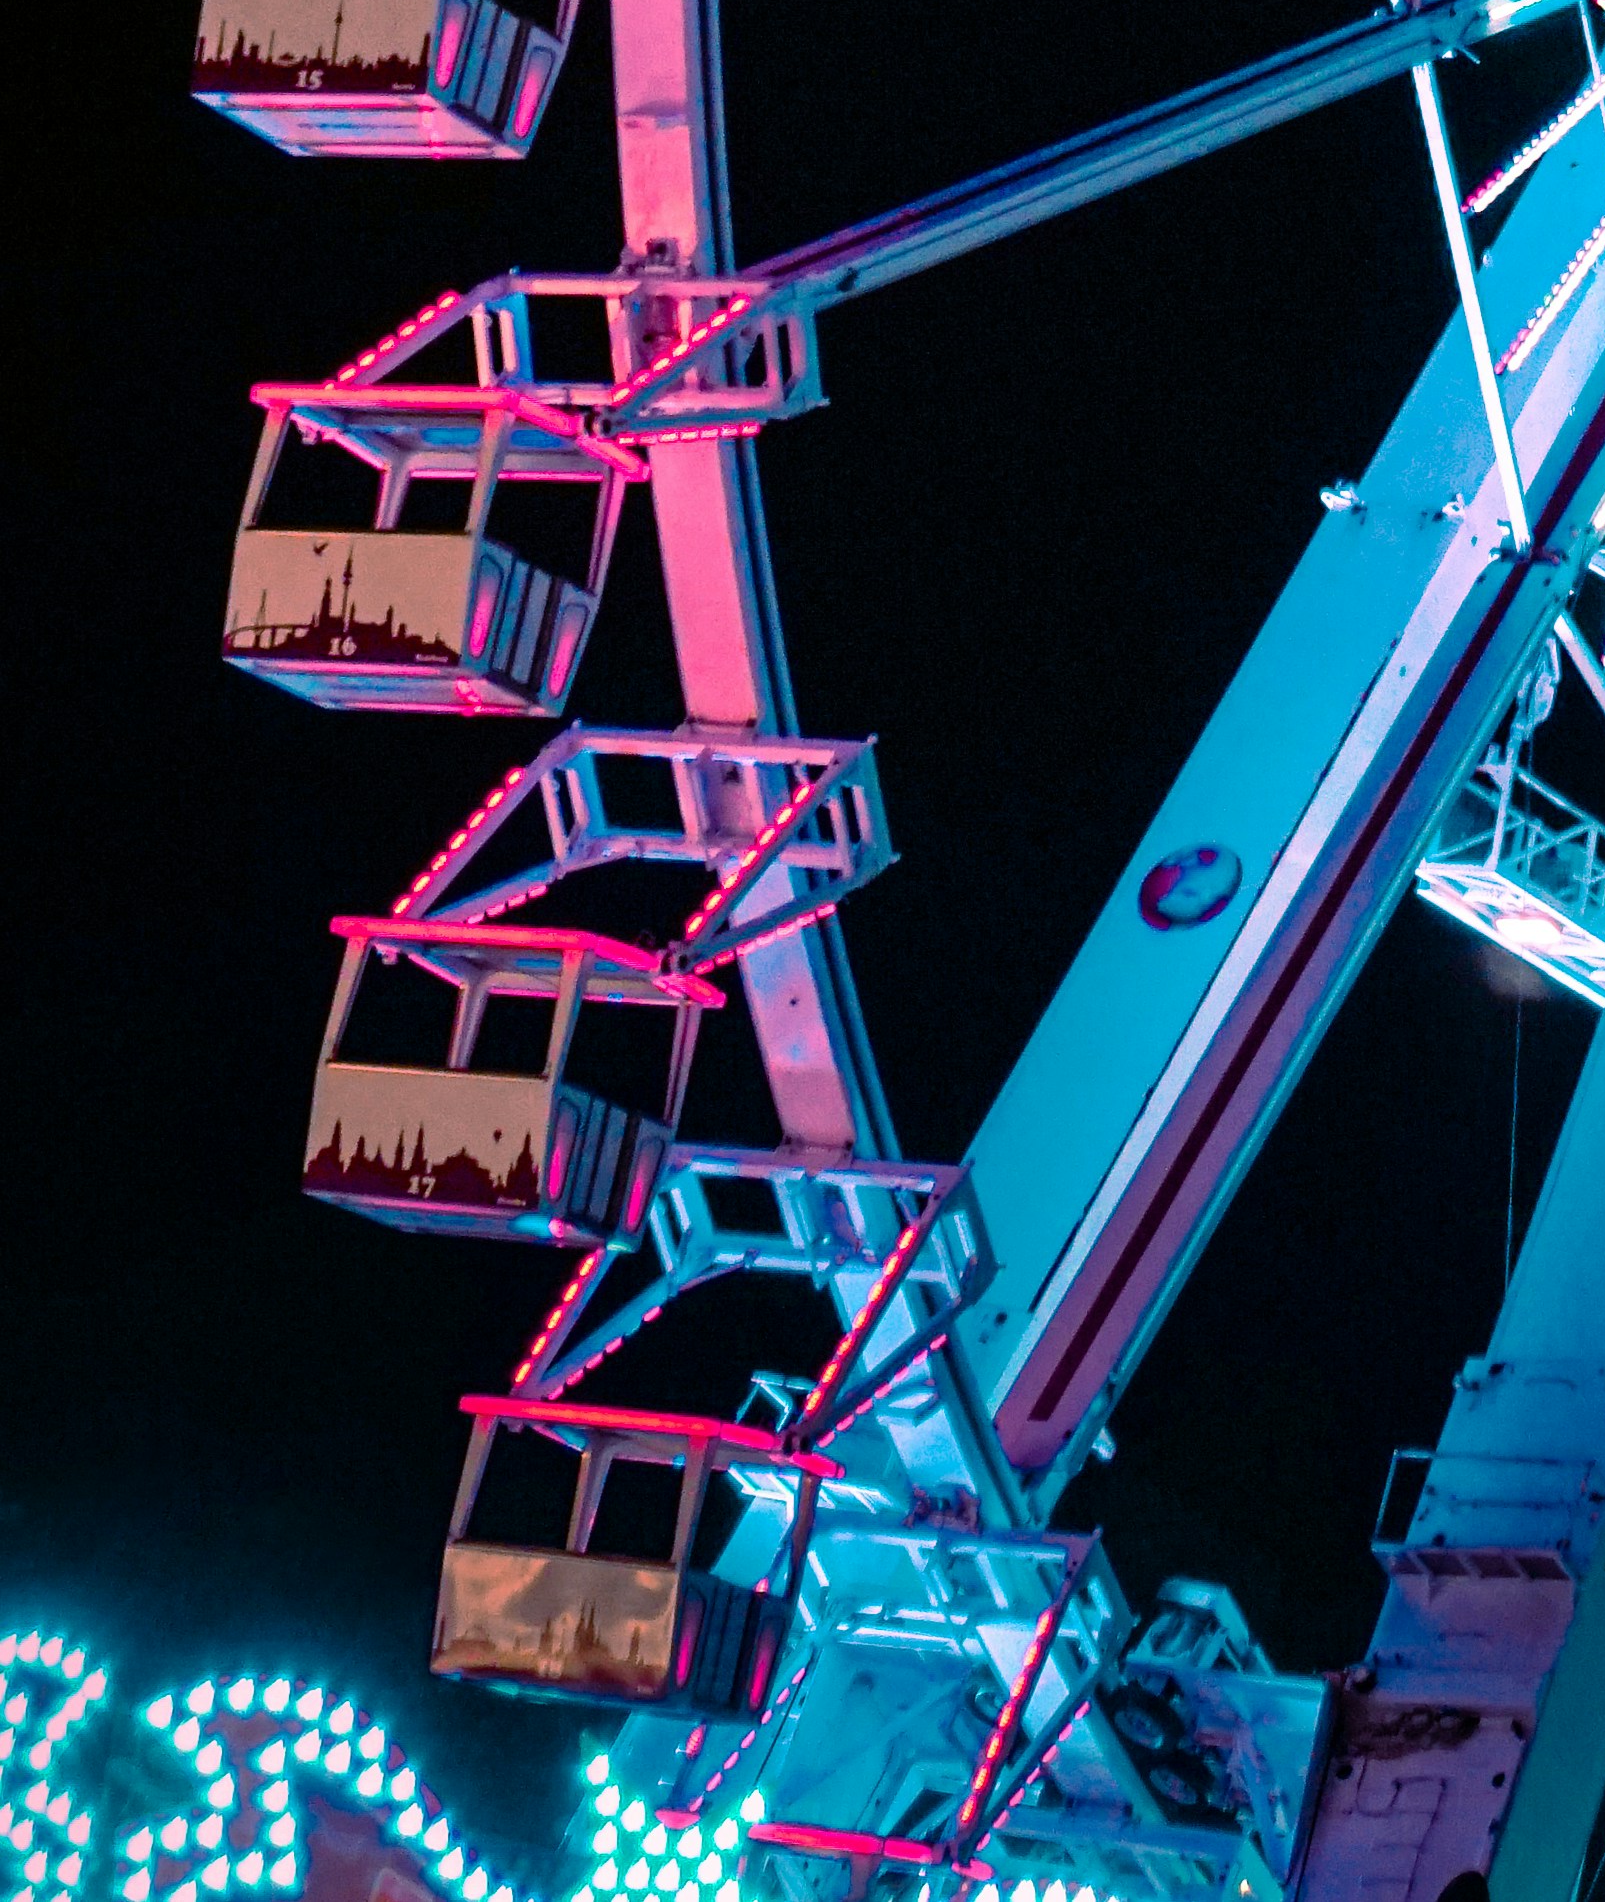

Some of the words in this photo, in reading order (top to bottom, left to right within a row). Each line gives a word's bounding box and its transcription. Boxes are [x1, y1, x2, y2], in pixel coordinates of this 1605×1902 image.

[297, 68, 325, 91] 15
[328, 635, 358, 657] 16
[407, 1173, 436, 1199] 17
